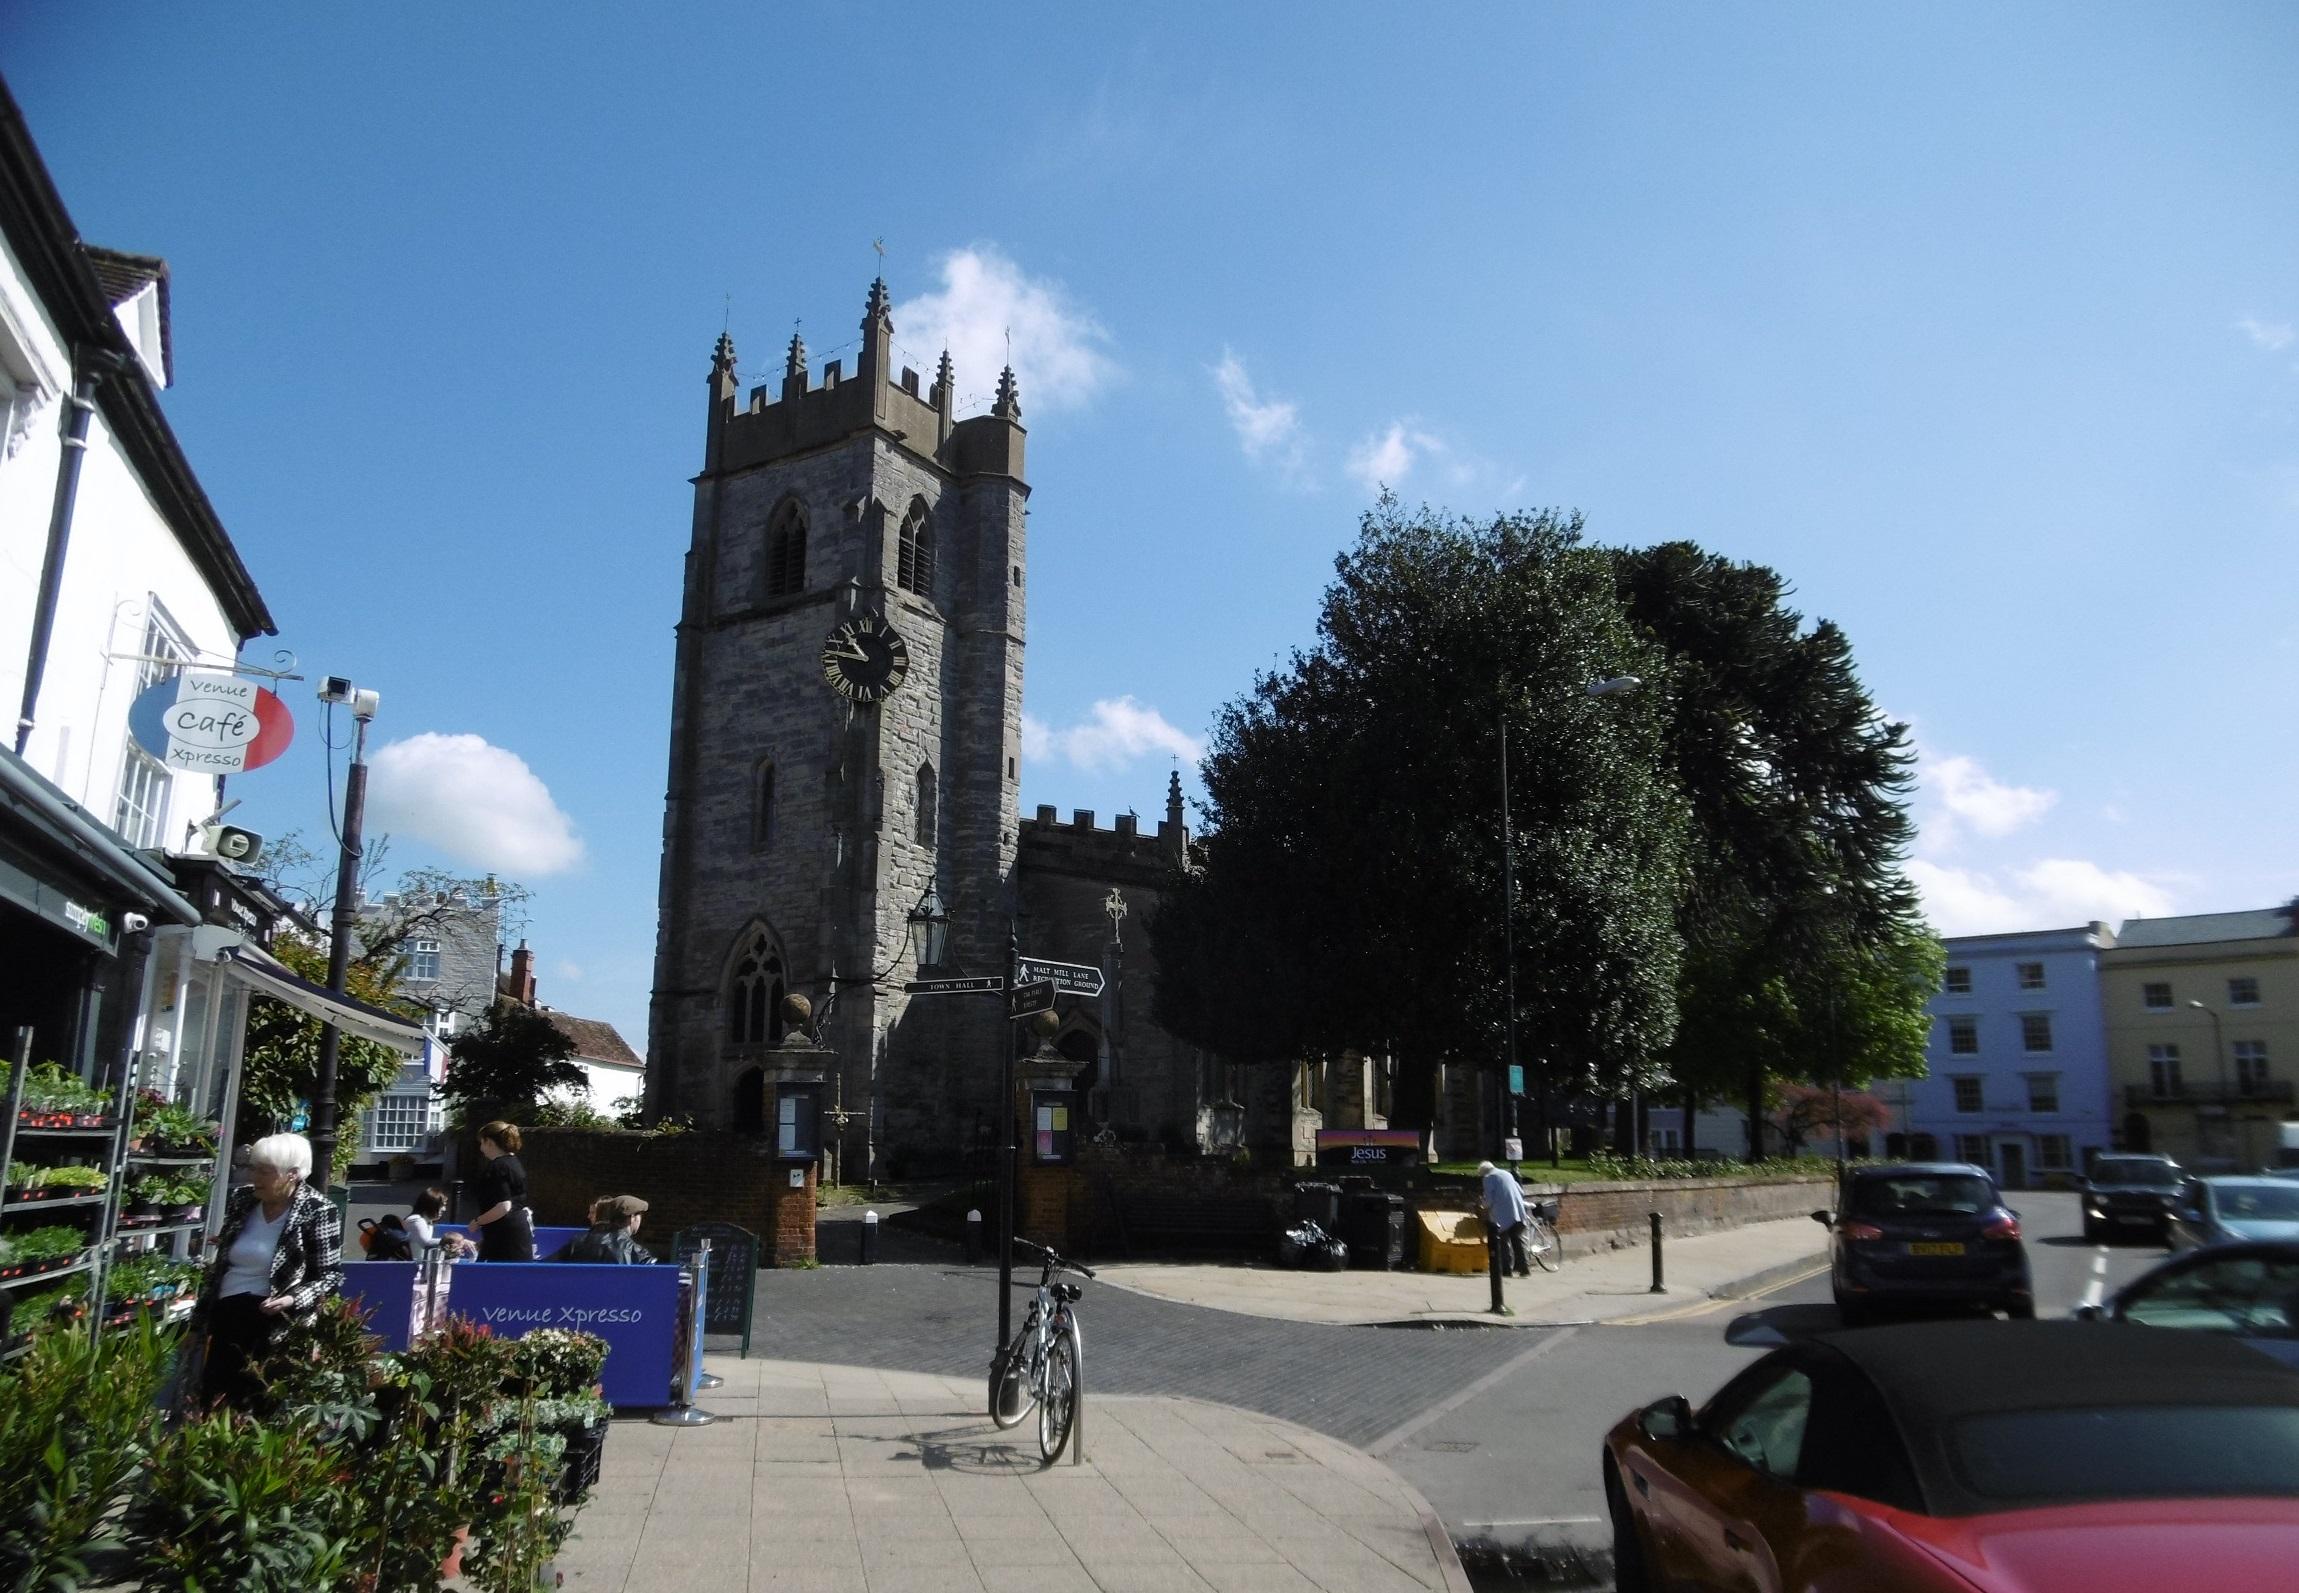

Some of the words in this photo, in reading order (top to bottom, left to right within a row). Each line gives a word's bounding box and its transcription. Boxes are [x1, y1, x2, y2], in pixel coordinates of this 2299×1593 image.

[1033, 966, 1050, 975] MALT
[1054, 969, 1069, 977] MILL
[1073, 972, 1089, 980] LANE
[929, 983, 951, 991] TOWN
[955, 981, 975, 989] HALL
[1033, 975, 1071, 986] RECTION
[1073, 980, 1099, 990] GROUND
[1351, 1146, 1387, 1160] Jesus
[482, 1306, 552, 1324] Venue
[557, 1306, 642, 1331] Xpresso
